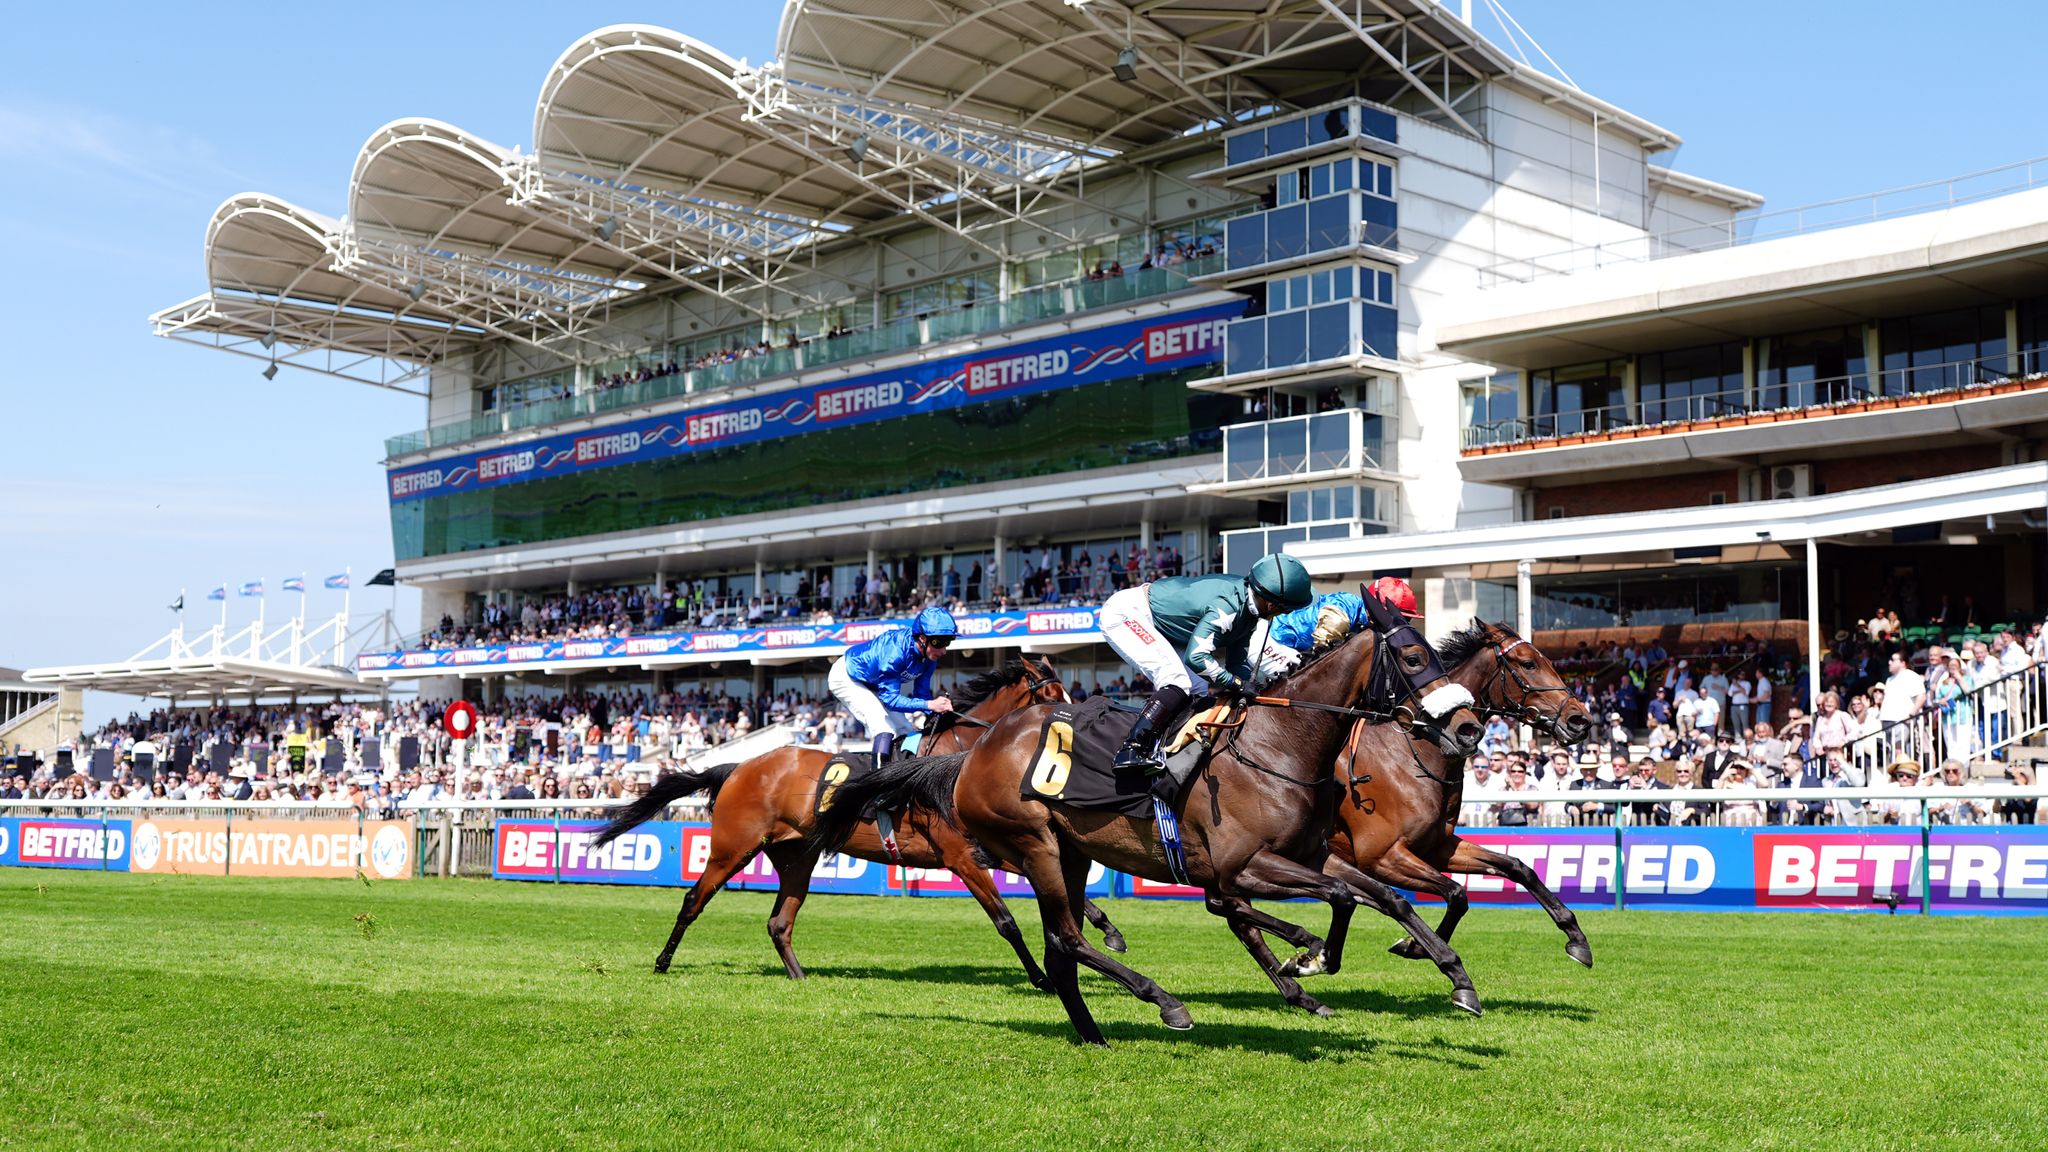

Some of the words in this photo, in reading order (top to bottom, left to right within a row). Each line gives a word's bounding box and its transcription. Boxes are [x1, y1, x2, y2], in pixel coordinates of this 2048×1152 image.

[1149, 316, 1243, 358] BETFR
[970, 349, 1069, 391] BETFRED
[819, 381, 903, 418] BETFRED
[688, 408, 762, 441] BETFRED
[577, 432, 640, 461] BETFRED
[393, 469, 442, 494] BETFRED
[480, 451, 535, 479] BETFRED
[767, 629, 816, 646] BETFRED
[955, 618, 992, 634] FRED
[1029, 612, 1093, 631] BETFRED
[694, 634, 739, 650] BETFRED
[1031, 721, 1073, 796] 6
[22, 827, 125, 860] BETFRED
[163, 831, 369, 867] TRUSTATRADER
[503, 831, 662, 871] BETFRED
